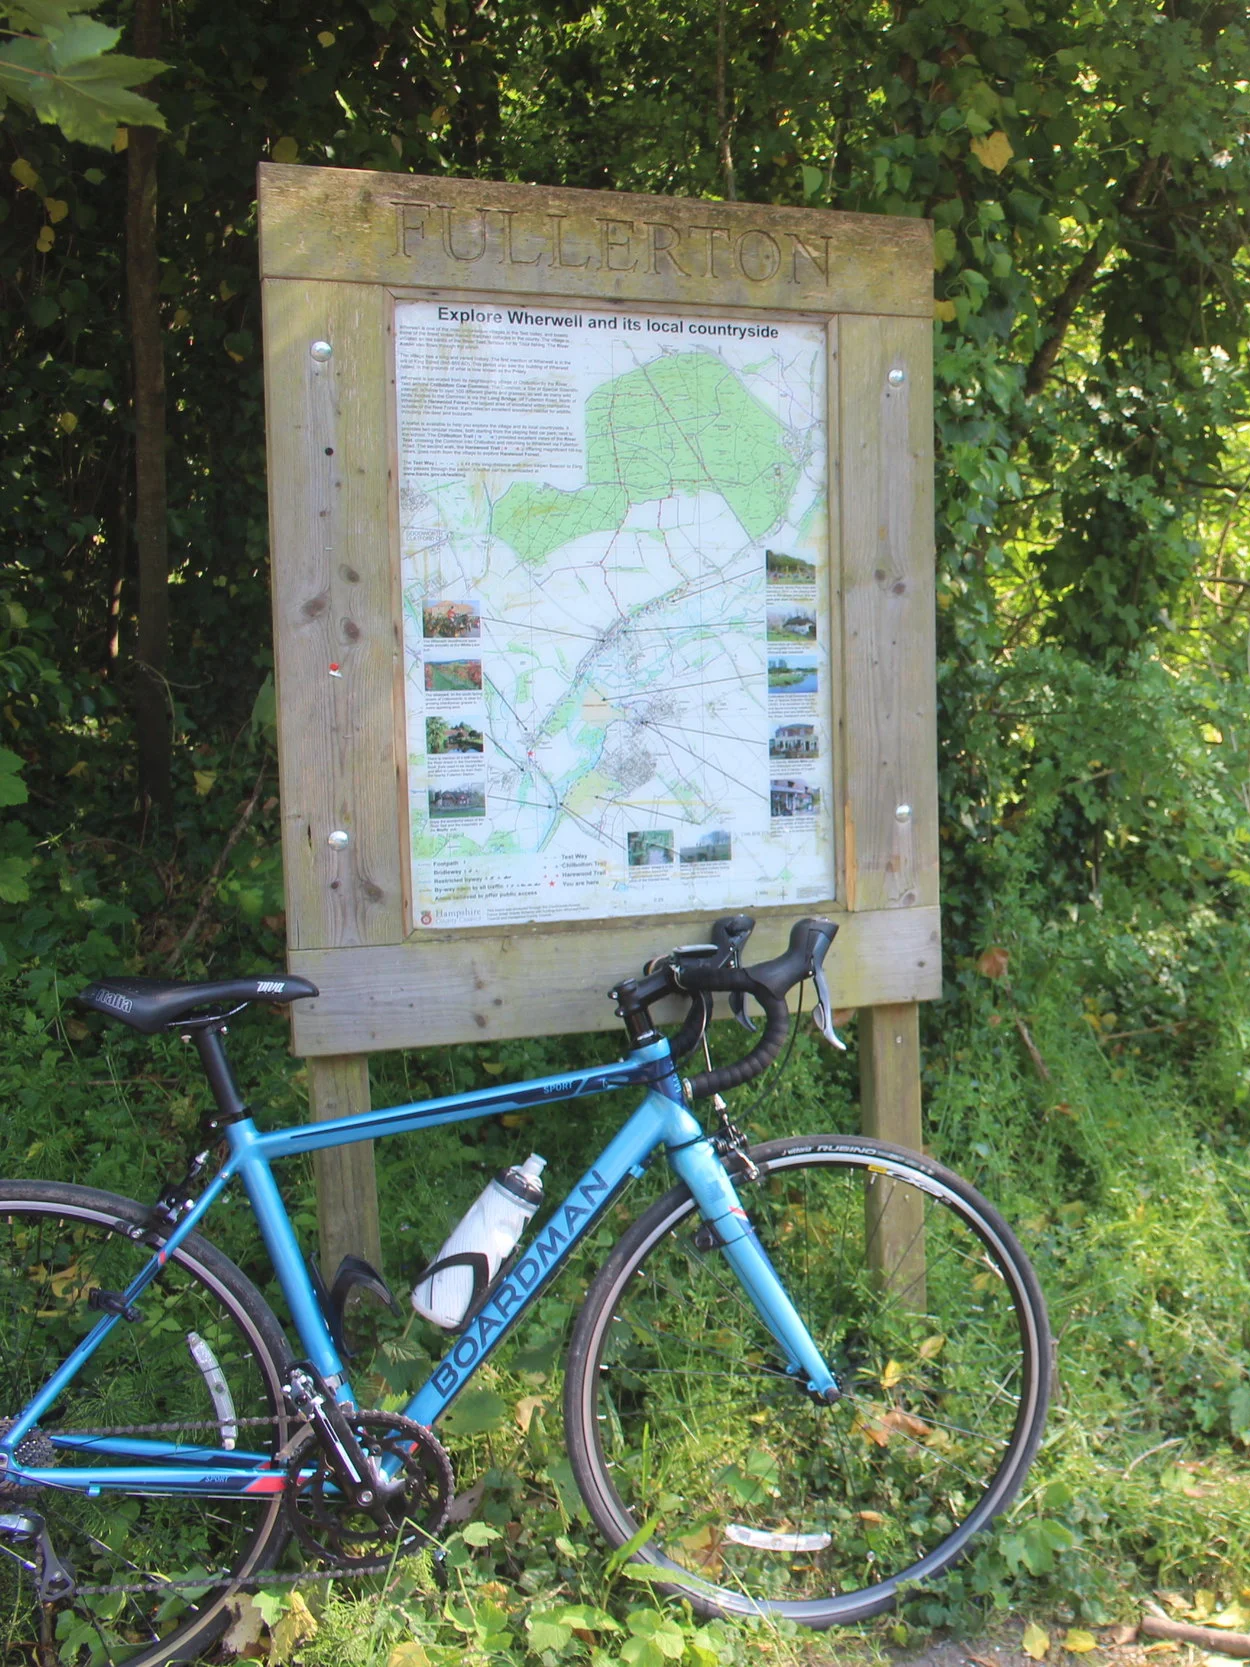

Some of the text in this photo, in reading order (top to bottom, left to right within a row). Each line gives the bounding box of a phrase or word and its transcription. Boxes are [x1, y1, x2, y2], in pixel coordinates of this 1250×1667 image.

[390, 201, 833, 287] FULLERTON
[438, 307, 779, 340] Explore Wherwell and its local countryside
[436, 907, 481, 919] Hampshire
[543, 1081, 573, 1094] SPORT
[817, 1144, 876, 1155] RUBINO
[431, 1170, 609, 1398] BOARDMAN
